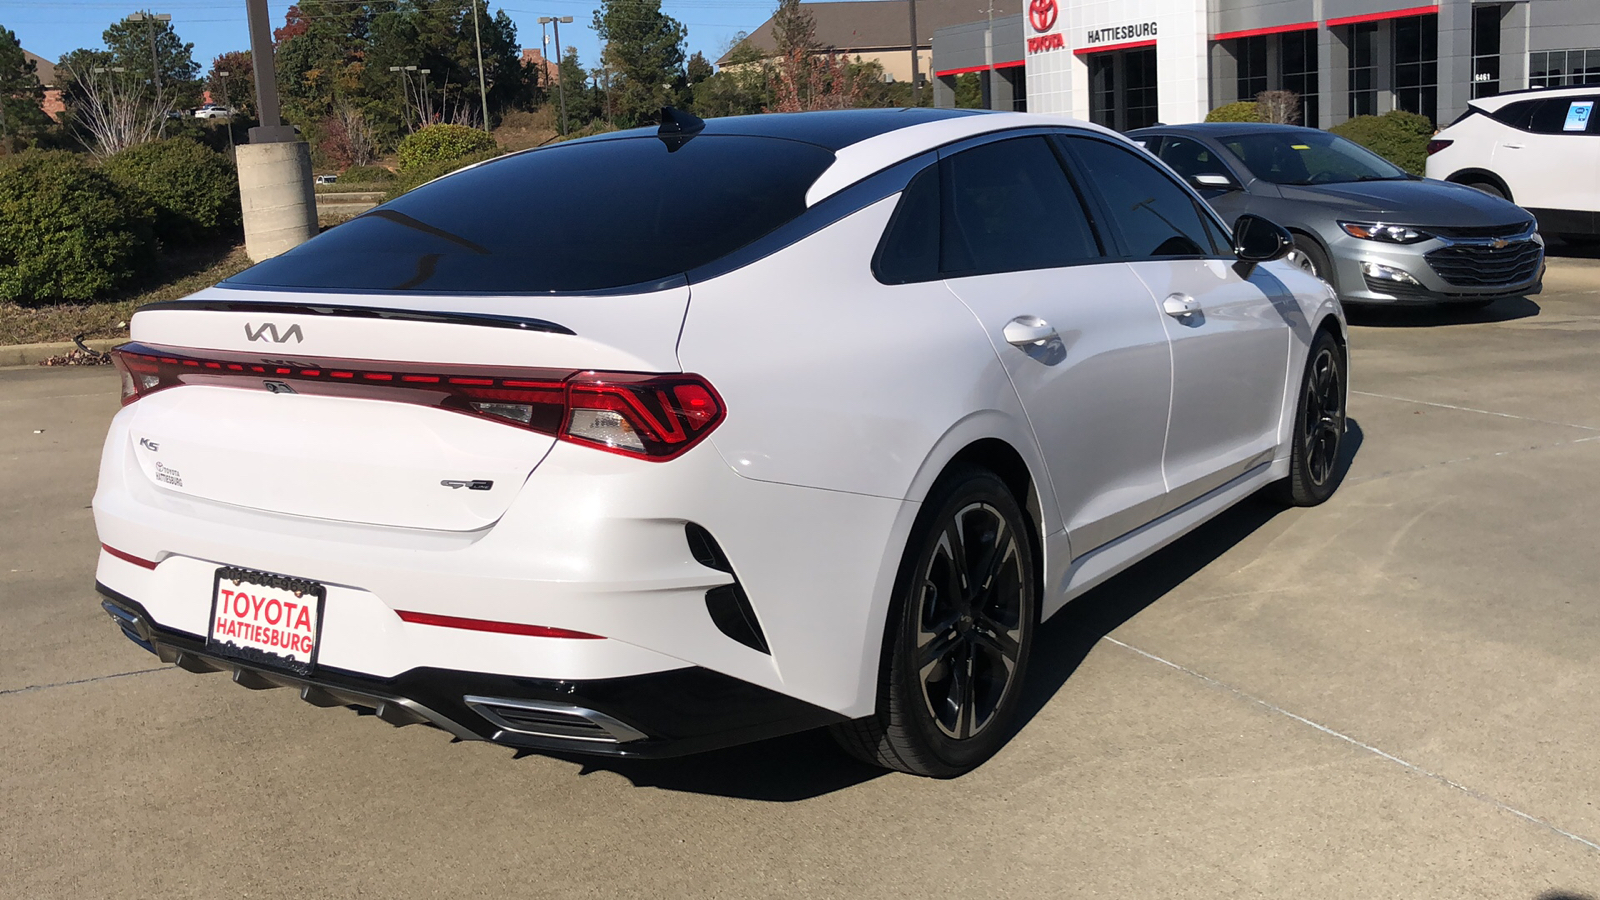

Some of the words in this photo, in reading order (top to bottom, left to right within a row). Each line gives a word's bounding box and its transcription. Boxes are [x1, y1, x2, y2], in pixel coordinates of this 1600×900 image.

[1088, 22, 1157, 43] HATTIESBURG
[1027, 33, 1065, 55] TOYOTA
[1475, 73, 1490, 81] 6461
[244, 322, 304, 344] KIA
[221, 589, 312, 632] TOYOTA
[216, 616, 313, 653] HATTIESBURG
